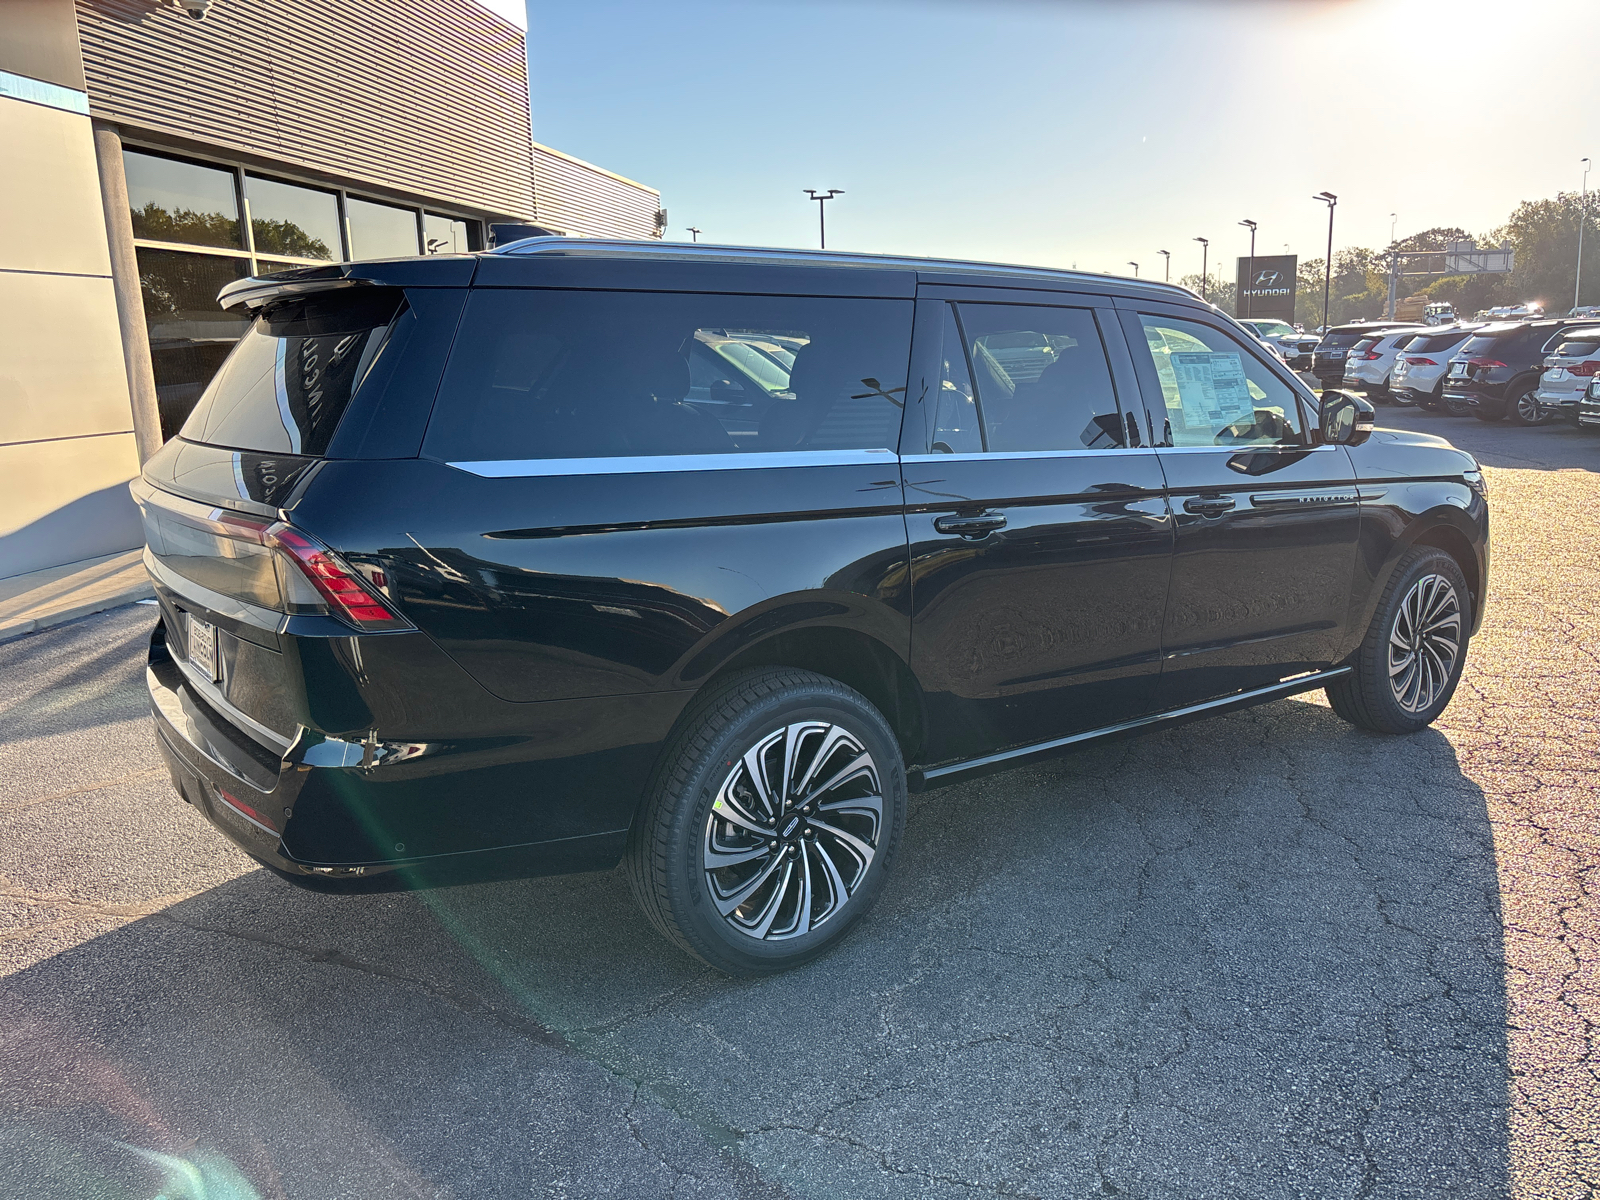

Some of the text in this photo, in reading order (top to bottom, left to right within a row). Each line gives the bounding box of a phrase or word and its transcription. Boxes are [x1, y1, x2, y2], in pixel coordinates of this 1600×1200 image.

[1244, 289, 1290, 297] HYUNDAI
[1299, 495, 1354, 503] NAVIGATOR
[709, 753, 730, 782] PRIMACY
[688, 792, 708, 880] MICHELIN
